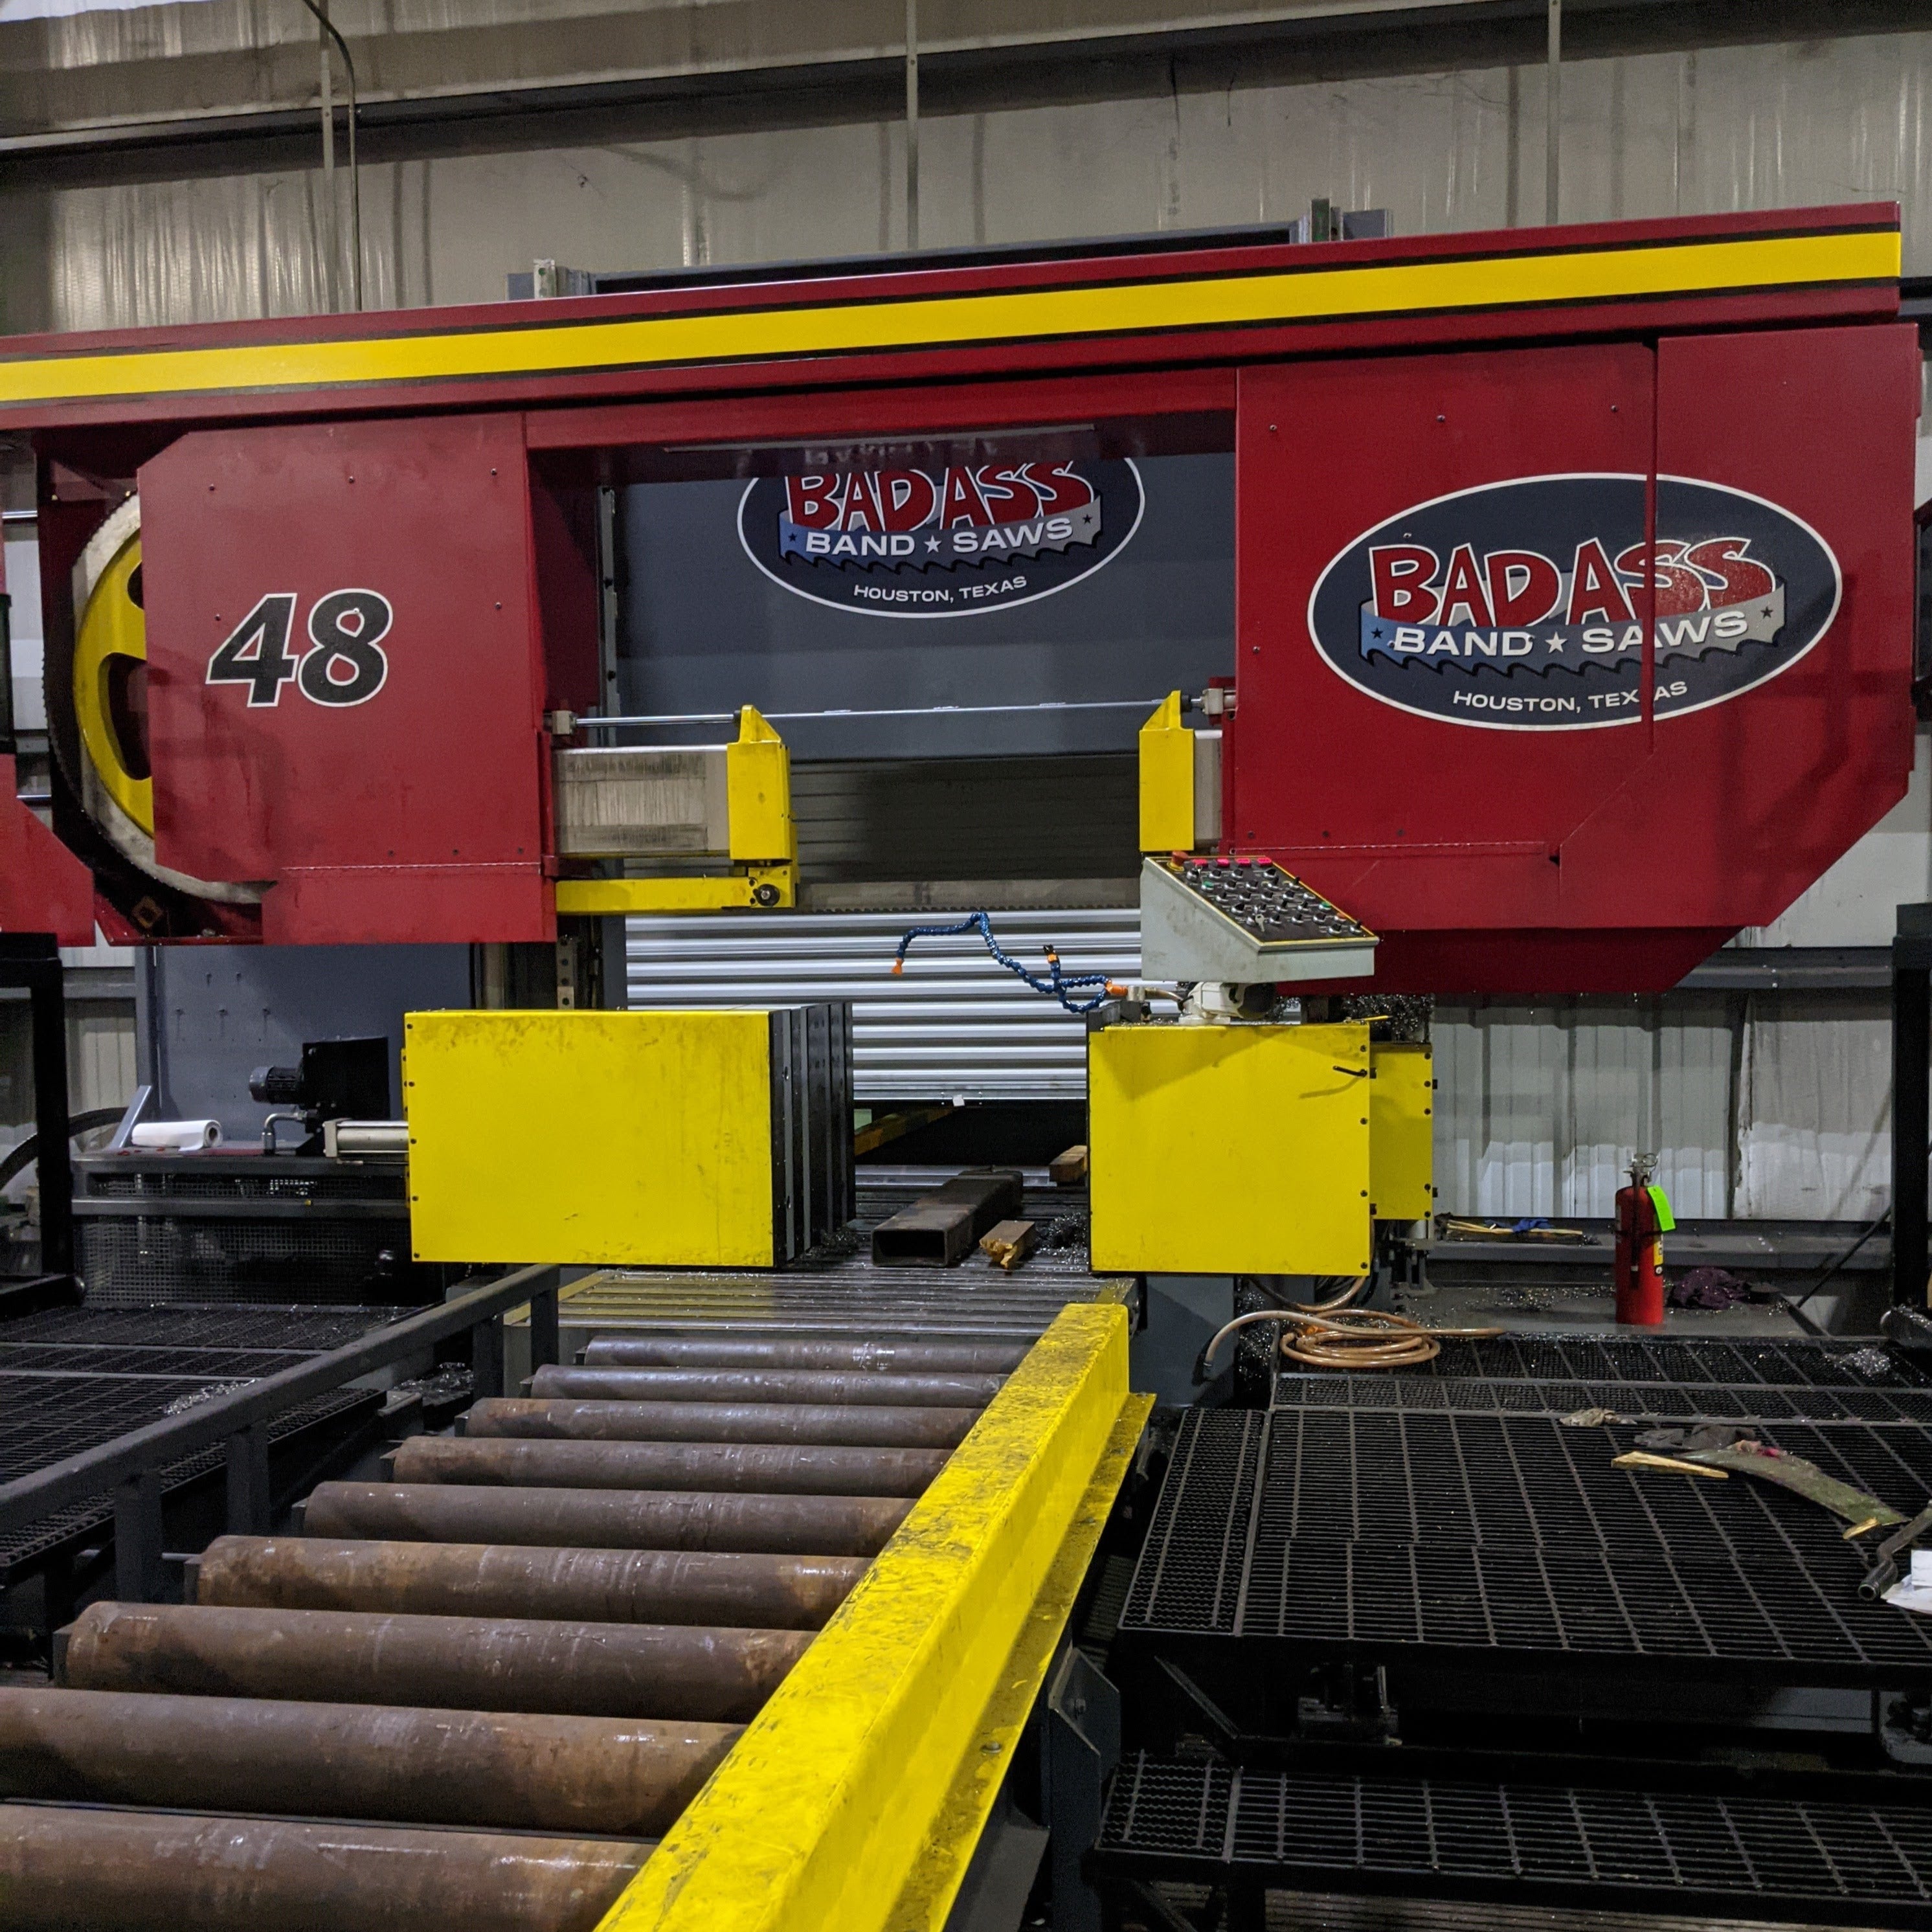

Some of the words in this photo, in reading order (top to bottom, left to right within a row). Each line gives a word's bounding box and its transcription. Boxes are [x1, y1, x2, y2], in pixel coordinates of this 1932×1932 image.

[805, 532, 915, 556] BAND
[952, 518, 1073, 553] SAWS
[853, 584, 954, 603] HOUSTON,
[959, 576, 1028, 600] TEXAS
[205, 588, 393, 708] 48
[1393, 627, 1533, 657] BAND
[1582, 611, 1747, 653] SAWS
[1453, 690, 1582, 713] HOUSTON,
[1588, 680, 1688, 710] TEXAS
